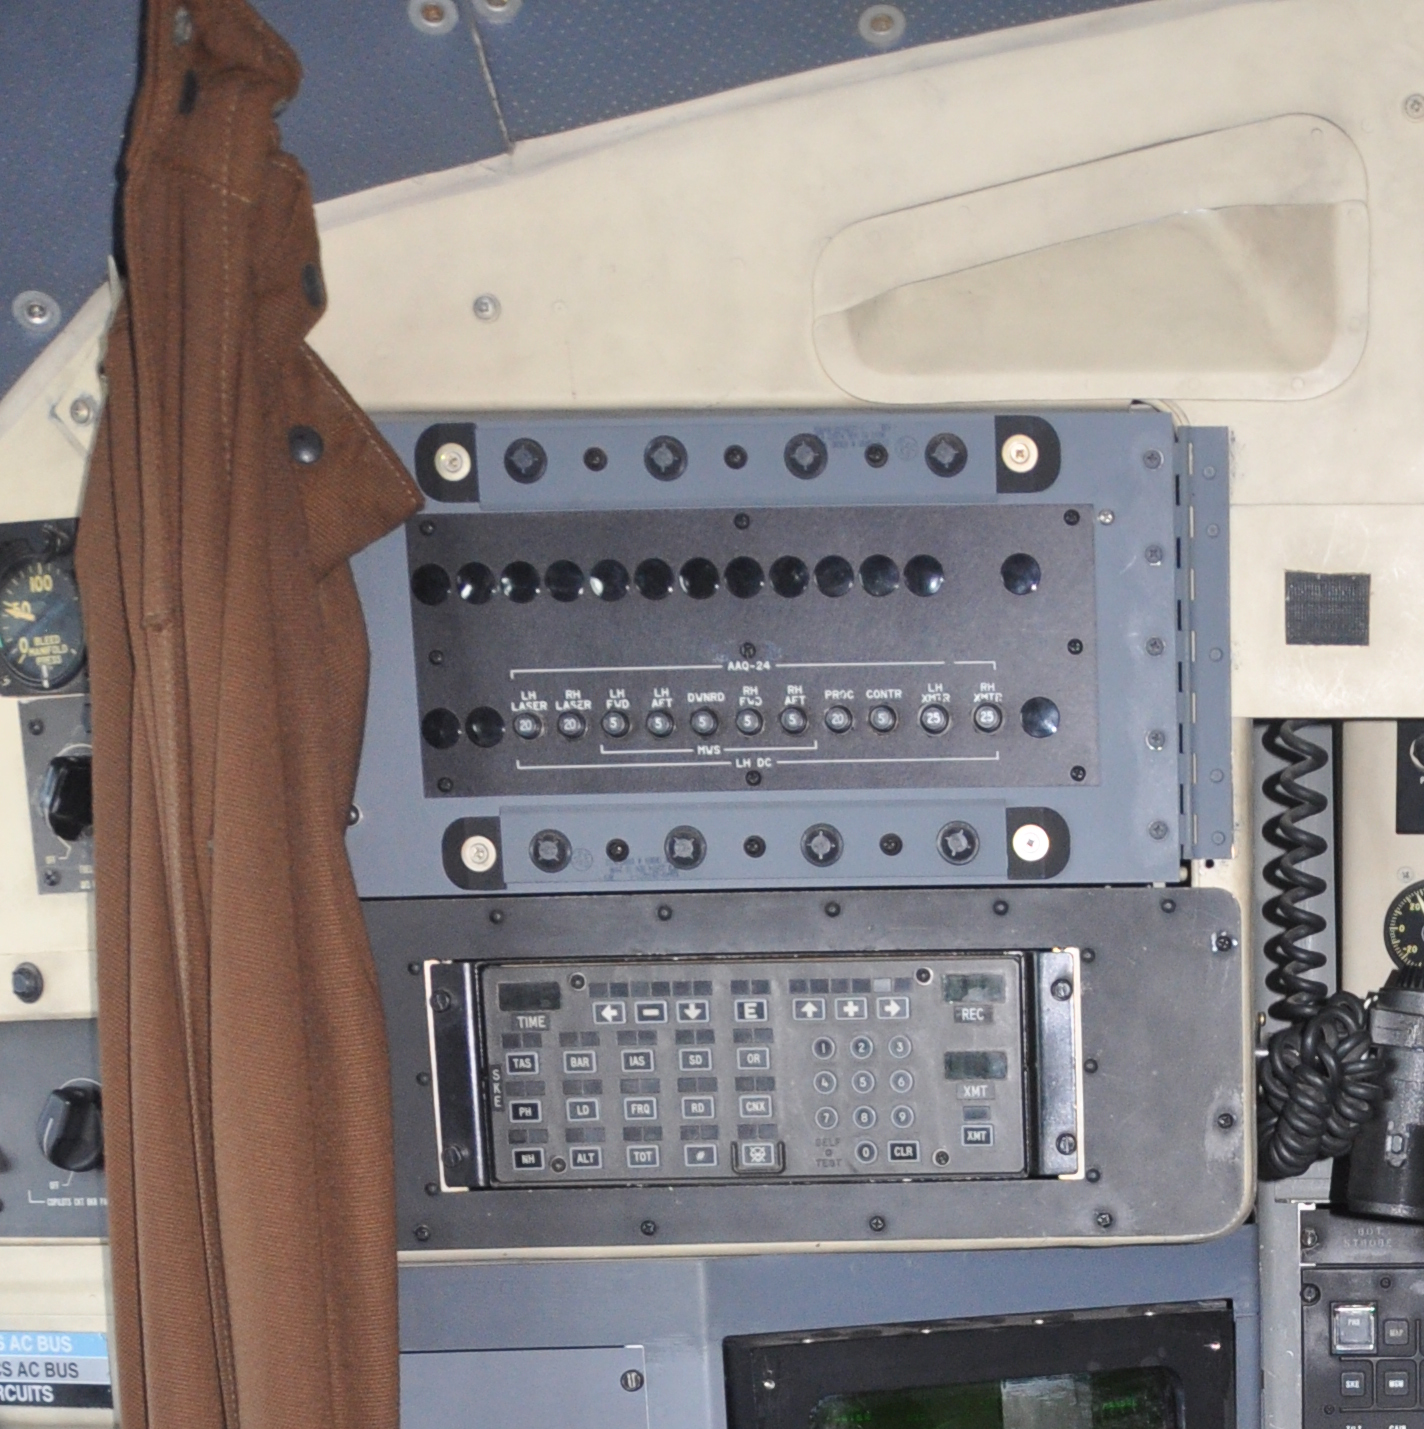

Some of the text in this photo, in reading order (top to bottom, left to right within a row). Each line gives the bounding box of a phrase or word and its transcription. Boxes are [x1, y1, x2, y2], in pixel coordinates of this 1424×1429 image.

[29, 574, 53, 593] 100
[727, 661, 770, 671] AAQ-24
[654, 688, 670, 697] LH
[742, 686, 759, 696] RH
[787, 685, 803, 695] RH
[927, 682, 943, 693] LH
[979, 682, 996, 692] RH
[520, 690, 537, 700] LH
[565, 689, 581, 699] RH
[609, 689, 625, 698] LH
[687, 692, 725, 703] DWNRD
[824, 689, 855, 700] PROC
[866, 688, 903, 699] CONTR
[606, 699, 630, 710] FWD
[651, 698, 673, 709] AFT
[784, 694, 806, 705] AFT
[511, 701, 548, 712] LASER
[555, 700, 592, 711] LASER
[926, 712, 941, 724] 25
[980, 711, 994, 723] 25
[519, 719, 533, 731] 20
[563, 718, 577, 730] 20
[697, 745, 721, 756] MWS
[735, 757, 772, 768] LH DC
[744, 1002, 758, 1019] E
[961, 1007, 985, 1021] REC
[516, 1015, 546, 1029] TIME
[512, 1056, 532, 1069] TAS
[570, 1056, 590, 1068] BAR
[629, 1055, 645, 1067] IAS
[688, 1054, 703, 1066] SD
[747, 1052, 761, 1064] OR
[963, 1085, 988, 1097] XMT
[518, 1106, 532, 1117] PH
[576, 1104, 590, 1116] LD
[631, 1103, 650, 1115] FRQ
[691, 1102, 704, 1114] RD
[746, 1101, 766, 1112] CNX
[966, 1130, 987, 1142] XMT
[633, 1151, 652, 1163] TOT
[893, 1146, 914, 1157] CLR
[521, 1154, 535, 1165] NH
[576, 1152, 595, 1164] ALT
[1344, 1238, 1392, 1248] STROBE
[10, 1335, 73, 1353] AC BUS
[18, 1361, 79, 1379] AC BUS
